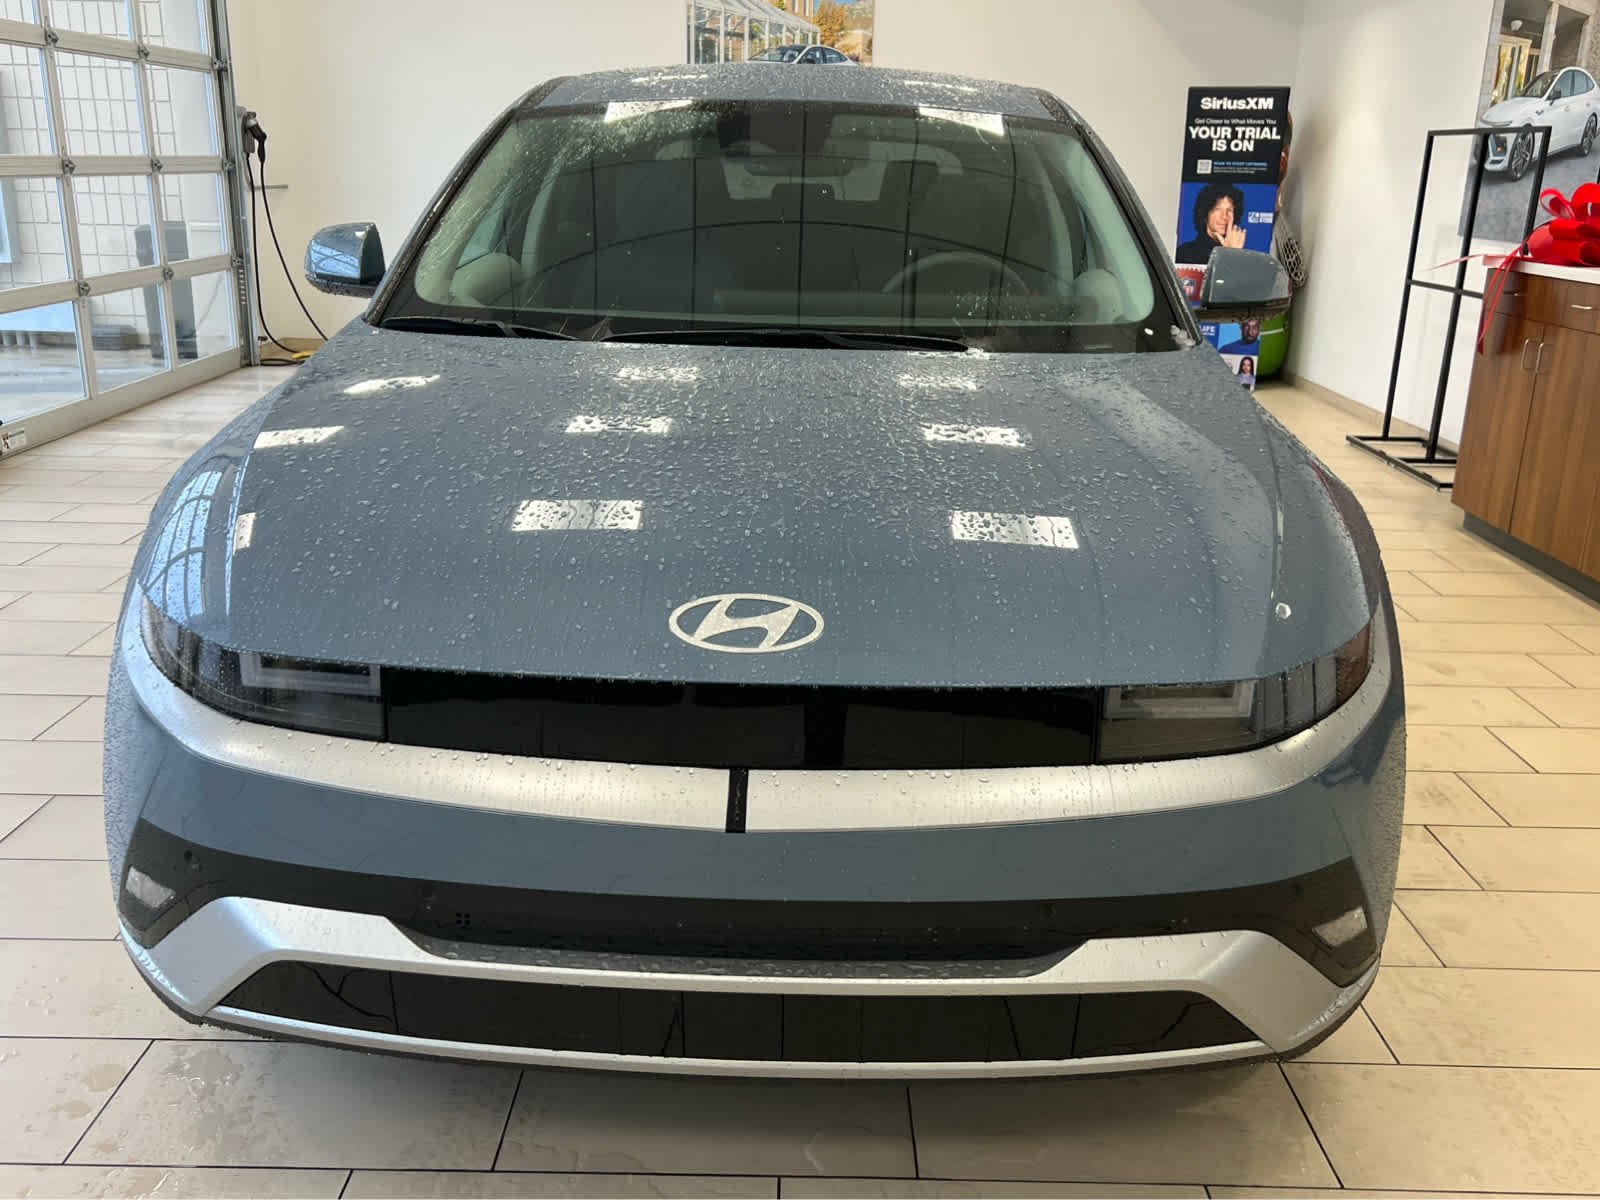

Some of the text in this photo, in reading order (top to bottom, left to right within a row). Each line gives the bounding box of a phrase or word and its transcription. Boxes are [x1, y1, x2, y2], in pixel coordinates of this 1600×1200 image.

[1200, 97, 1274, 110] SiriusXM
[1188, 126, 1281, 140] YOUR TRIAL
[1212, 139, 1255, 152] IS ON
